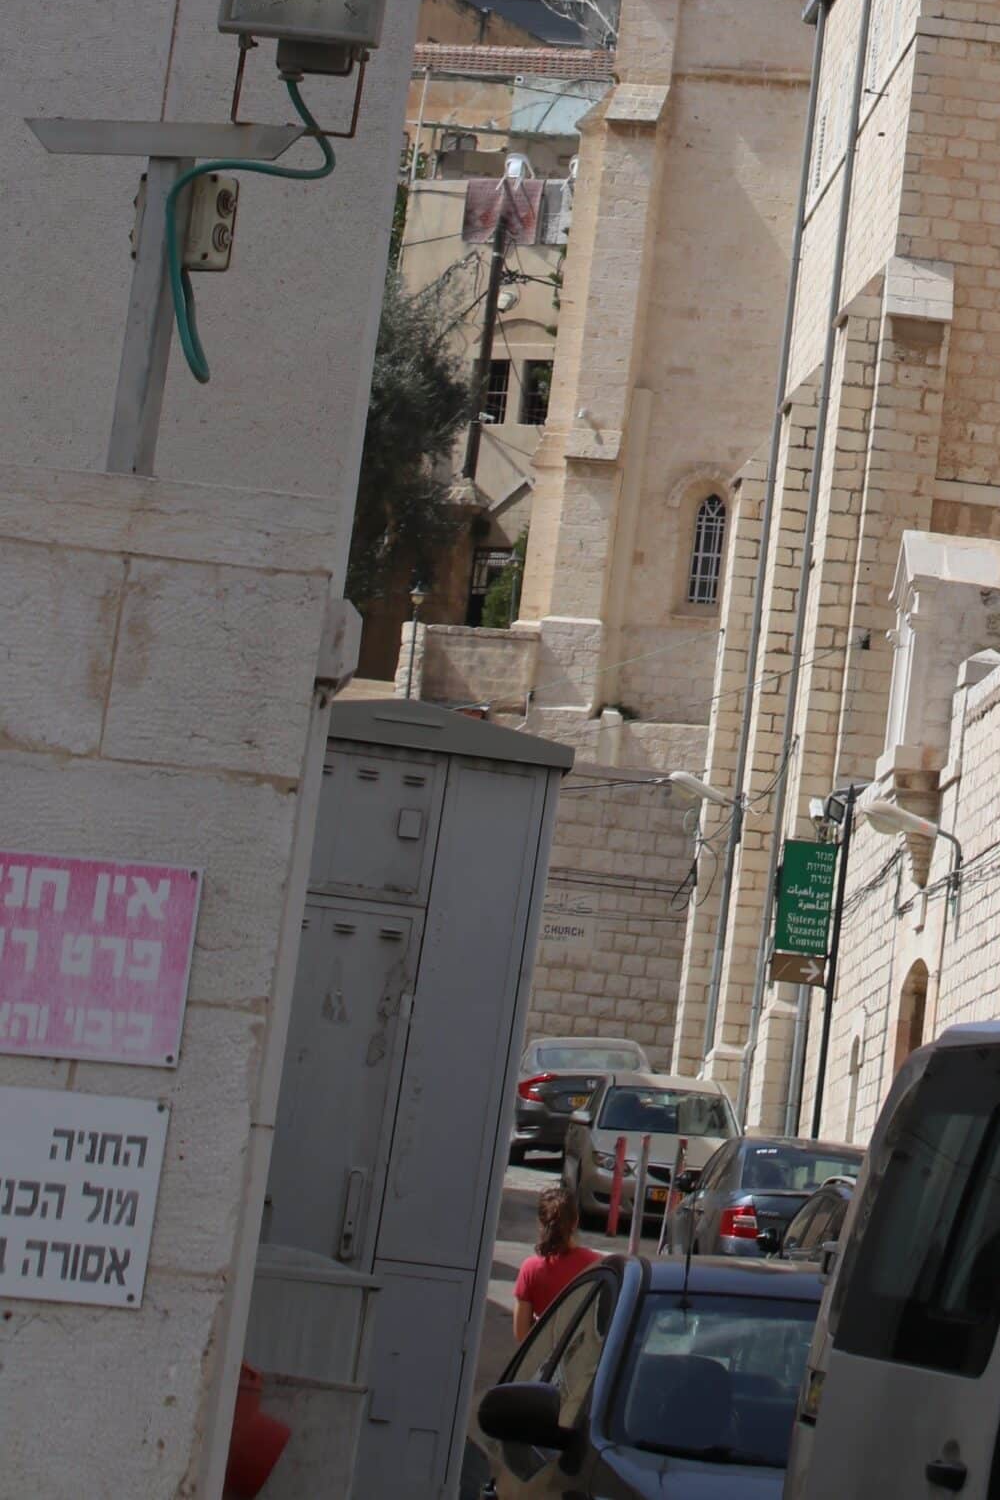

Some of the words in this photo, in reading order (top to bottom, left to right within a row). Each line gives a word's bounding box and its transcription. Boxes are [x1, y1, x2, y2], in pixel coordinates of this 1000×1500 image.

[816, 851, 834, 861] מנזר
[0, 864, 70, 913] חנ
[92, 873, 171, 922] אין
[810, 874, 832, 884] נצרת
[544, 925, 584, 937] CHURCH
[786, 924, 826, 937] Nazareth
[787, 912, 816, 925] Sisters
[818, 916, 827, 926] of
[60, 934, 163, 980] פרט
[789, 935, 825, 948] Convent
[49, 1128, 148, 1168] החניה
[0, 1178, 67, 1220] הכנ
[82, 1181, 139, 1227] מול
[21, 1239, 131, 1286] אסורה
